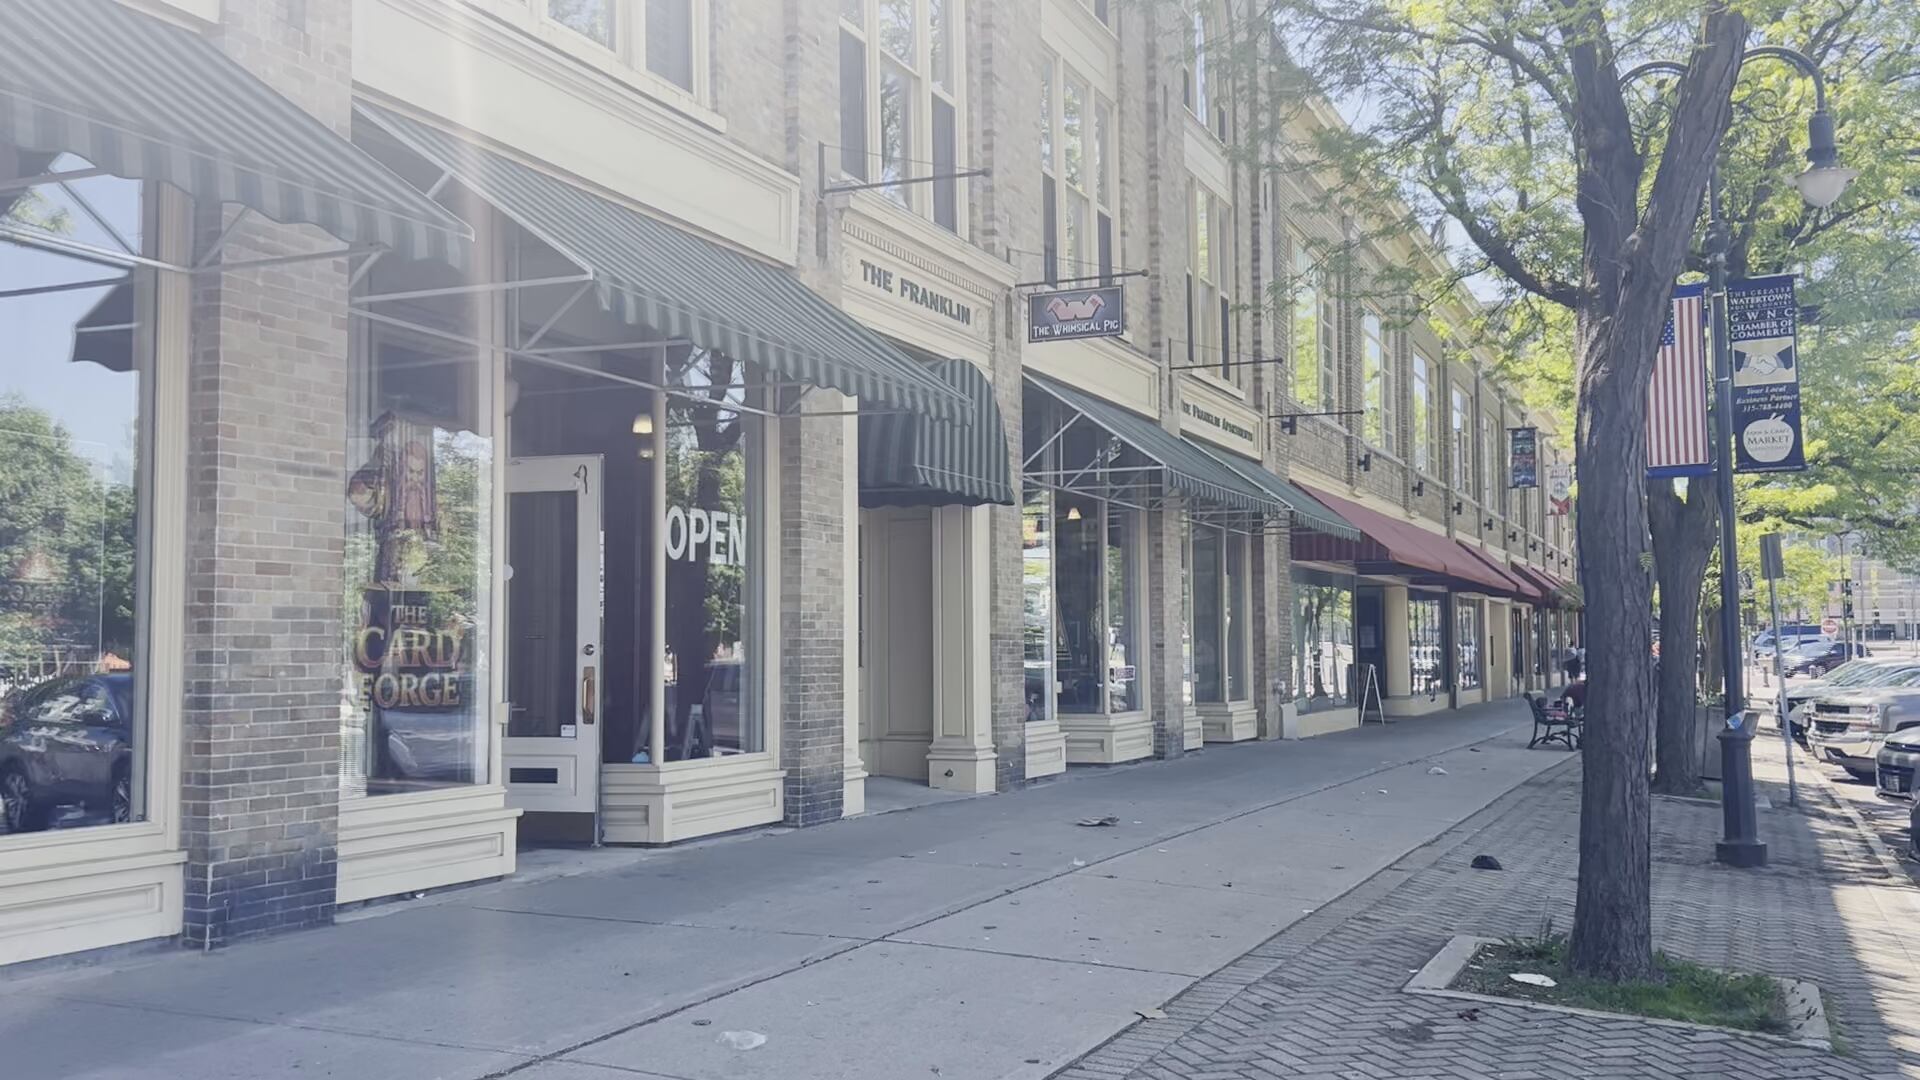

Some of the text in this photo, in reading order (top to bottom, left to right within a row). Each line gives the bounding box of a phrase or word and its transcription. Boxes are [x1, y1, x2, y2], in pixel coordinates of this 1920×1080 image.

[860, 259, 971, 325] THE FRANKLIN
[1730, 293, 1792, 305] WATERTOWN
[1751, 287, 1791, 296] GREATER
[1033, 320, 1119, 337] THE WHIMSICAL PIG
[1730, 319, 1793, 332] CHAMBER OF
[1731, 327, 1794, 340] COMMERCE
[1747, 435, 1790, 445] MARKET
[665, 505, 747, 566] OPEN
[392, 605, 428, 624] THE
[357, 626, 463, 669] CARD
[360, 672, 460, 707] FORGE
